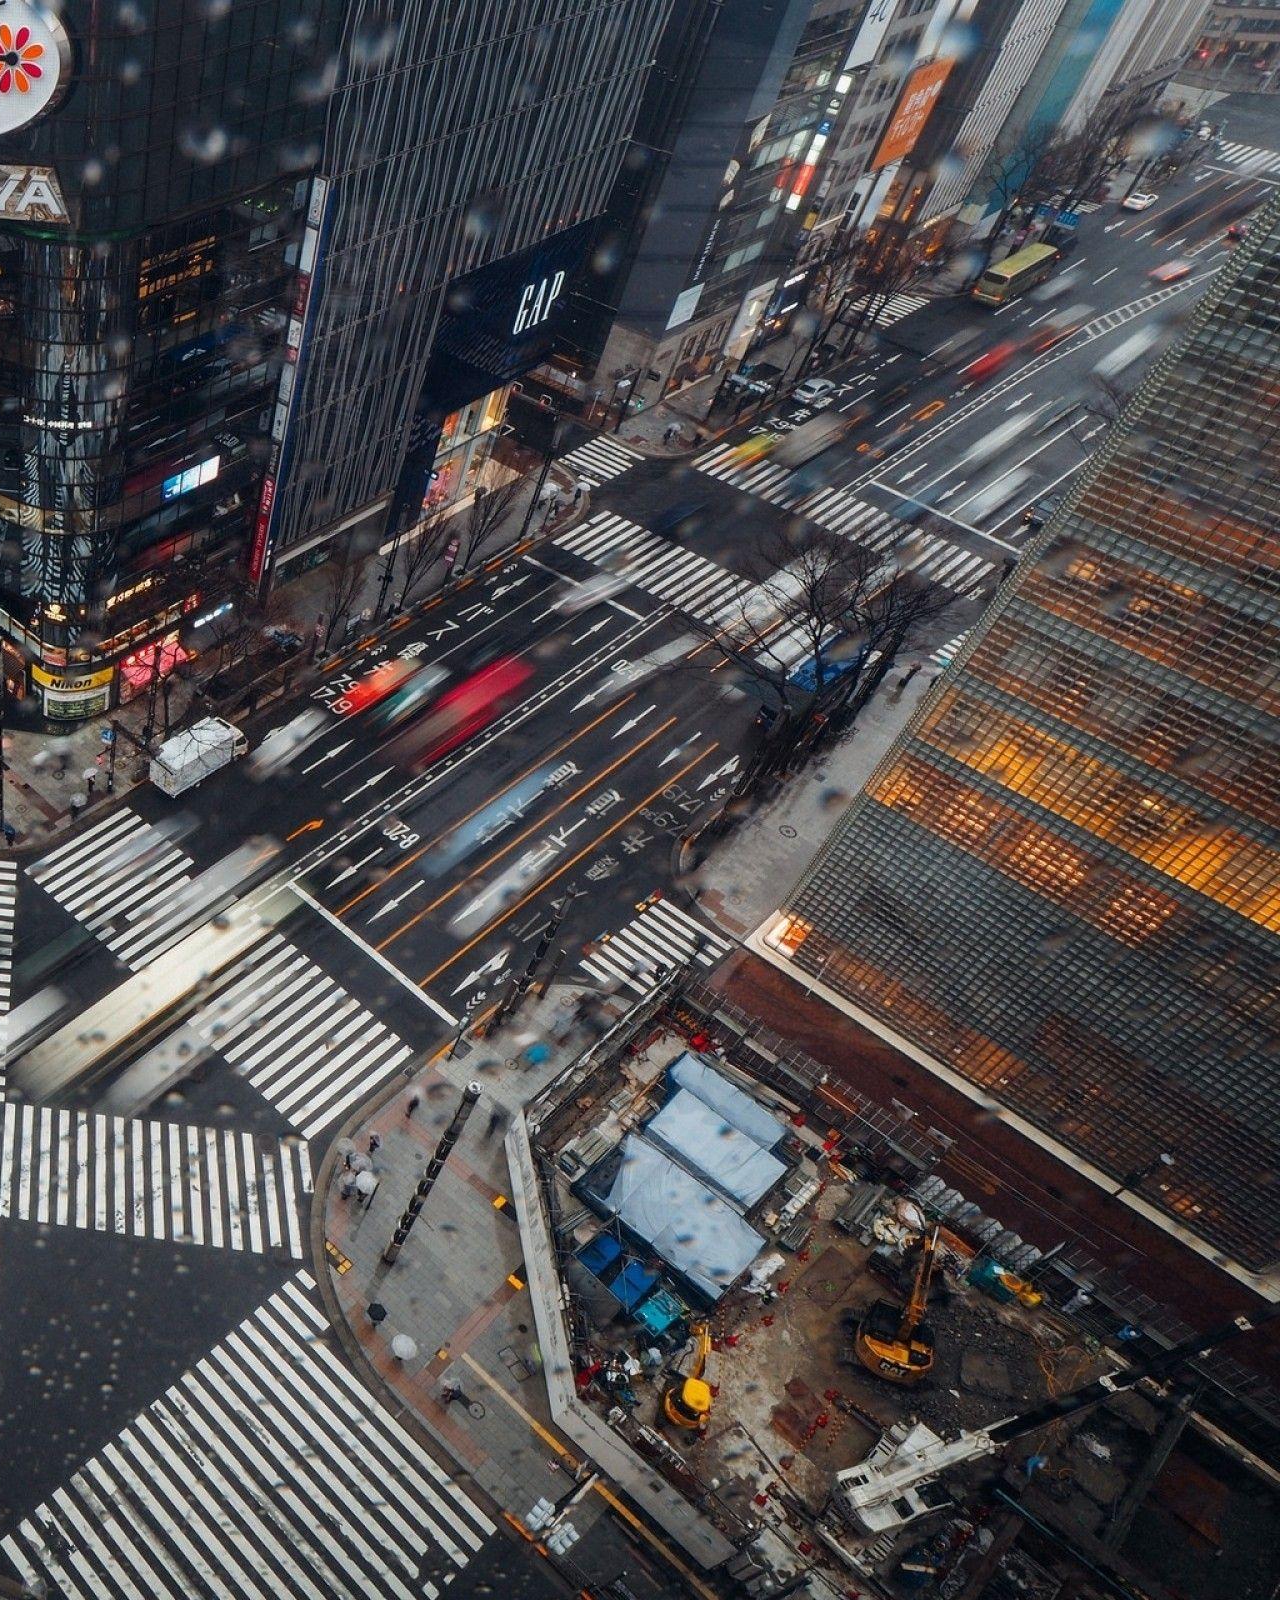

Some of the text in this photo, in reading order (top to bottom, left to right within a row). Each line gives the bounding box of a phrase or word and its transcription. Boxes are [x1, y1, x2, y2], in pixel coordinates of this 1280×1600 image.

[513, 270, 565, 335] GAP
[50, 677, 93, 690] Nikon
[382, 822, 421, 851] 8-20
